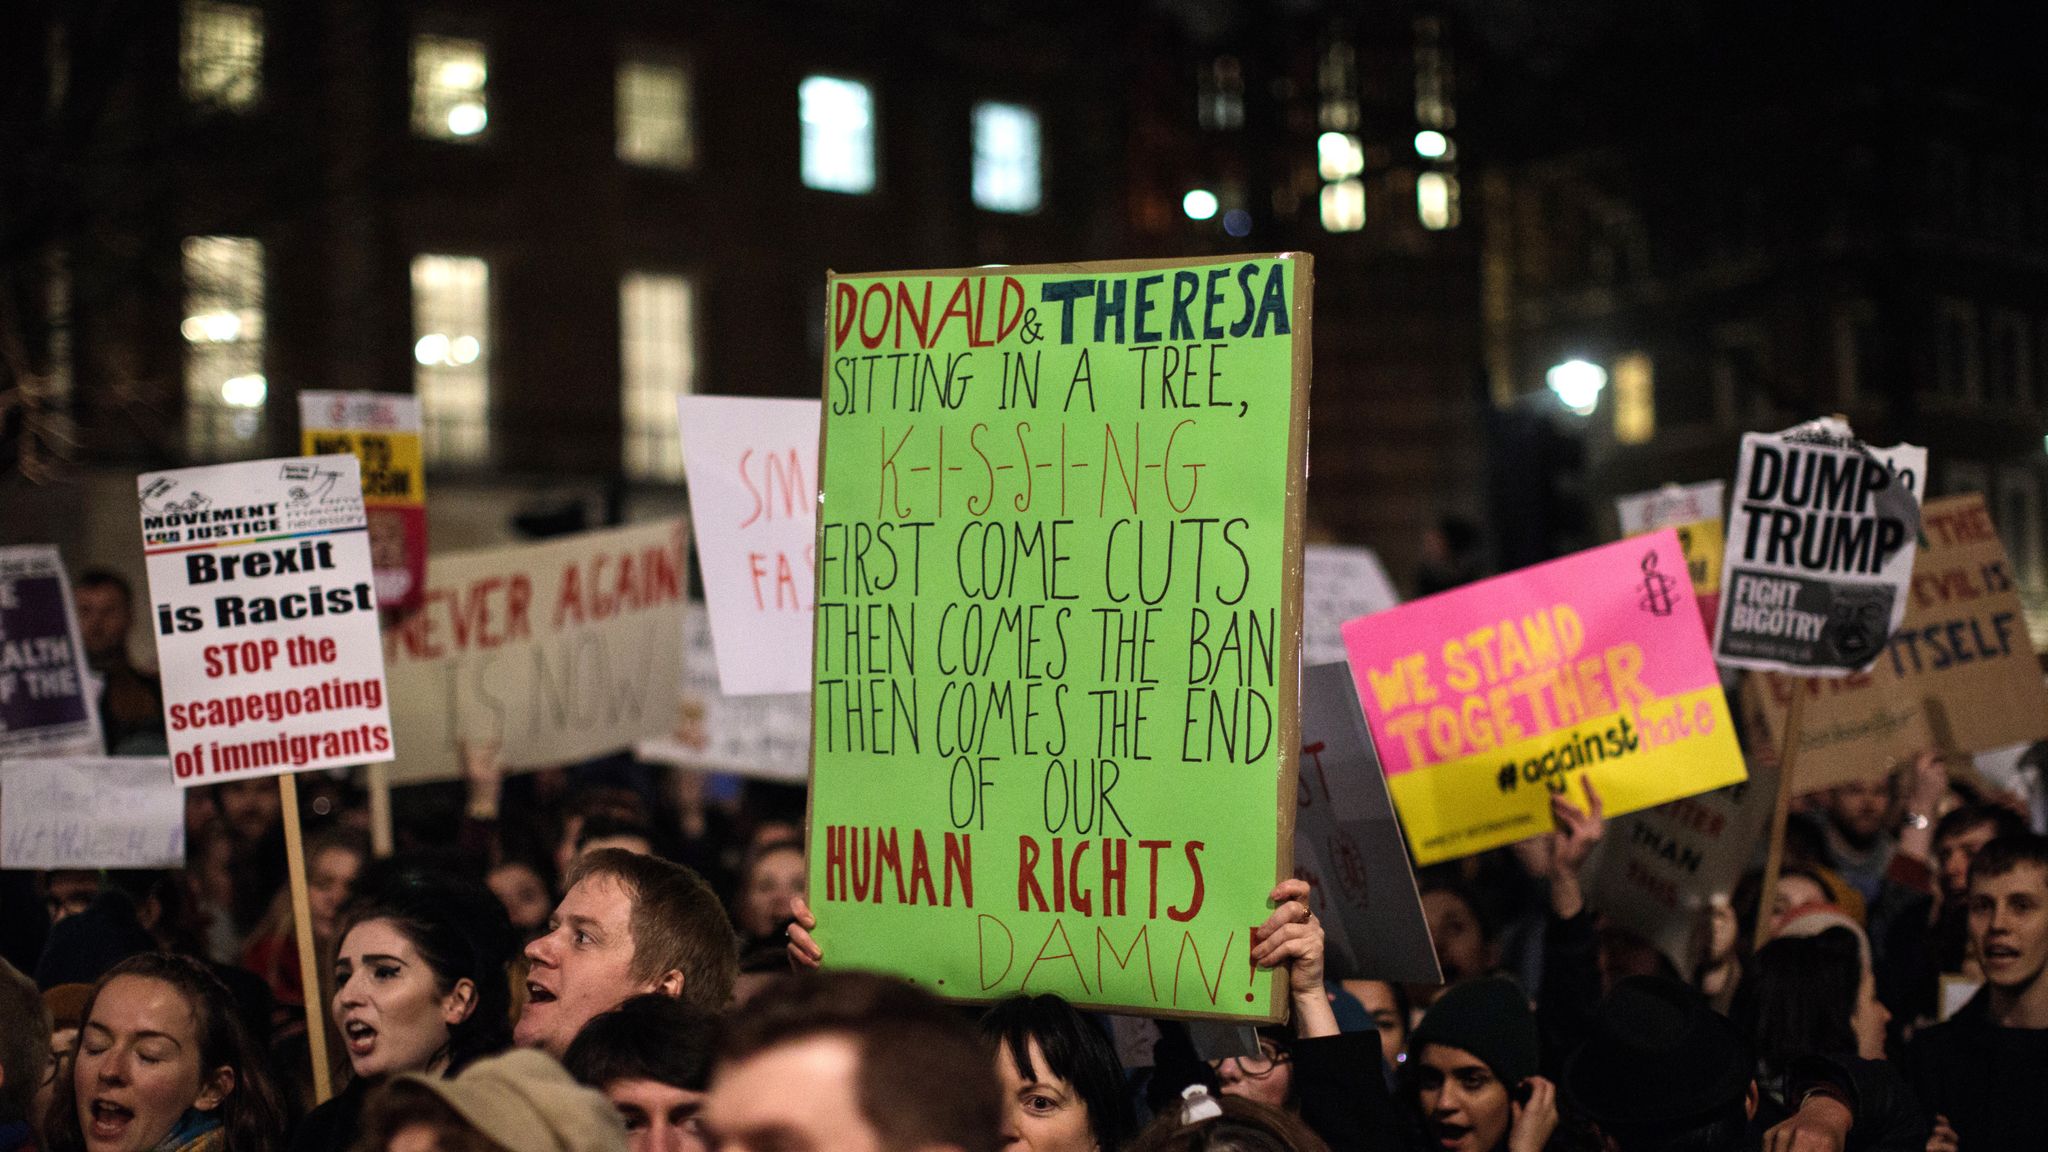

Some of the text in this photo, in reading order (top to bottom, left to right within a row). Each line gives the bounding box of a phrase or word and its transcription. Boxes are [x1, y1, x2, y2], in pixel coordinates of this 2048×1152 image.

[835, 263, 1291, 352] DONALD & THERESA
[833, 344, 1248, 417] SITTING IN A TREE,
[1748, 447, 1890, 512] DUMP
[144, 502, 278, 530] MOVEMENT
[187, 519, 281, 541] JUSTICE
[1743, 504, 1904, 574] TRUMP
[186, 540, 336, 586] Brexit
[822, 521, 935, 597] FIRST
[957, 520, 1079, 600] COME
[1106, 518, 1249, 605] CUTS
[1735, 576, 1802, 607] FIGHT
[158, 582, 373, 635] is Racist
[1731, 605, 1828, 642] BIGOTRY
[204, 635, 337, 679] STOP the
[819, 602, 1275, 687] THEN COMES THE BAN
[1368, 653, 1438, 714] WE
[1443, 604, 1584, 693] STAND
[1889, 611, 2014, 678] ITSELF
[169, 678, 383, 732] scapegoating
[819, 678, 1273, 764] THEN COMES THE END
[1384, 643, 1655, 770] TOGETHER
[174, 724, 390, 778] of immigrants
[949, 755, 1132, 837] OF OUR
[826, 824, 974, 908] HUMAN
[1018, 834, 1206, 922] RIGHTS
